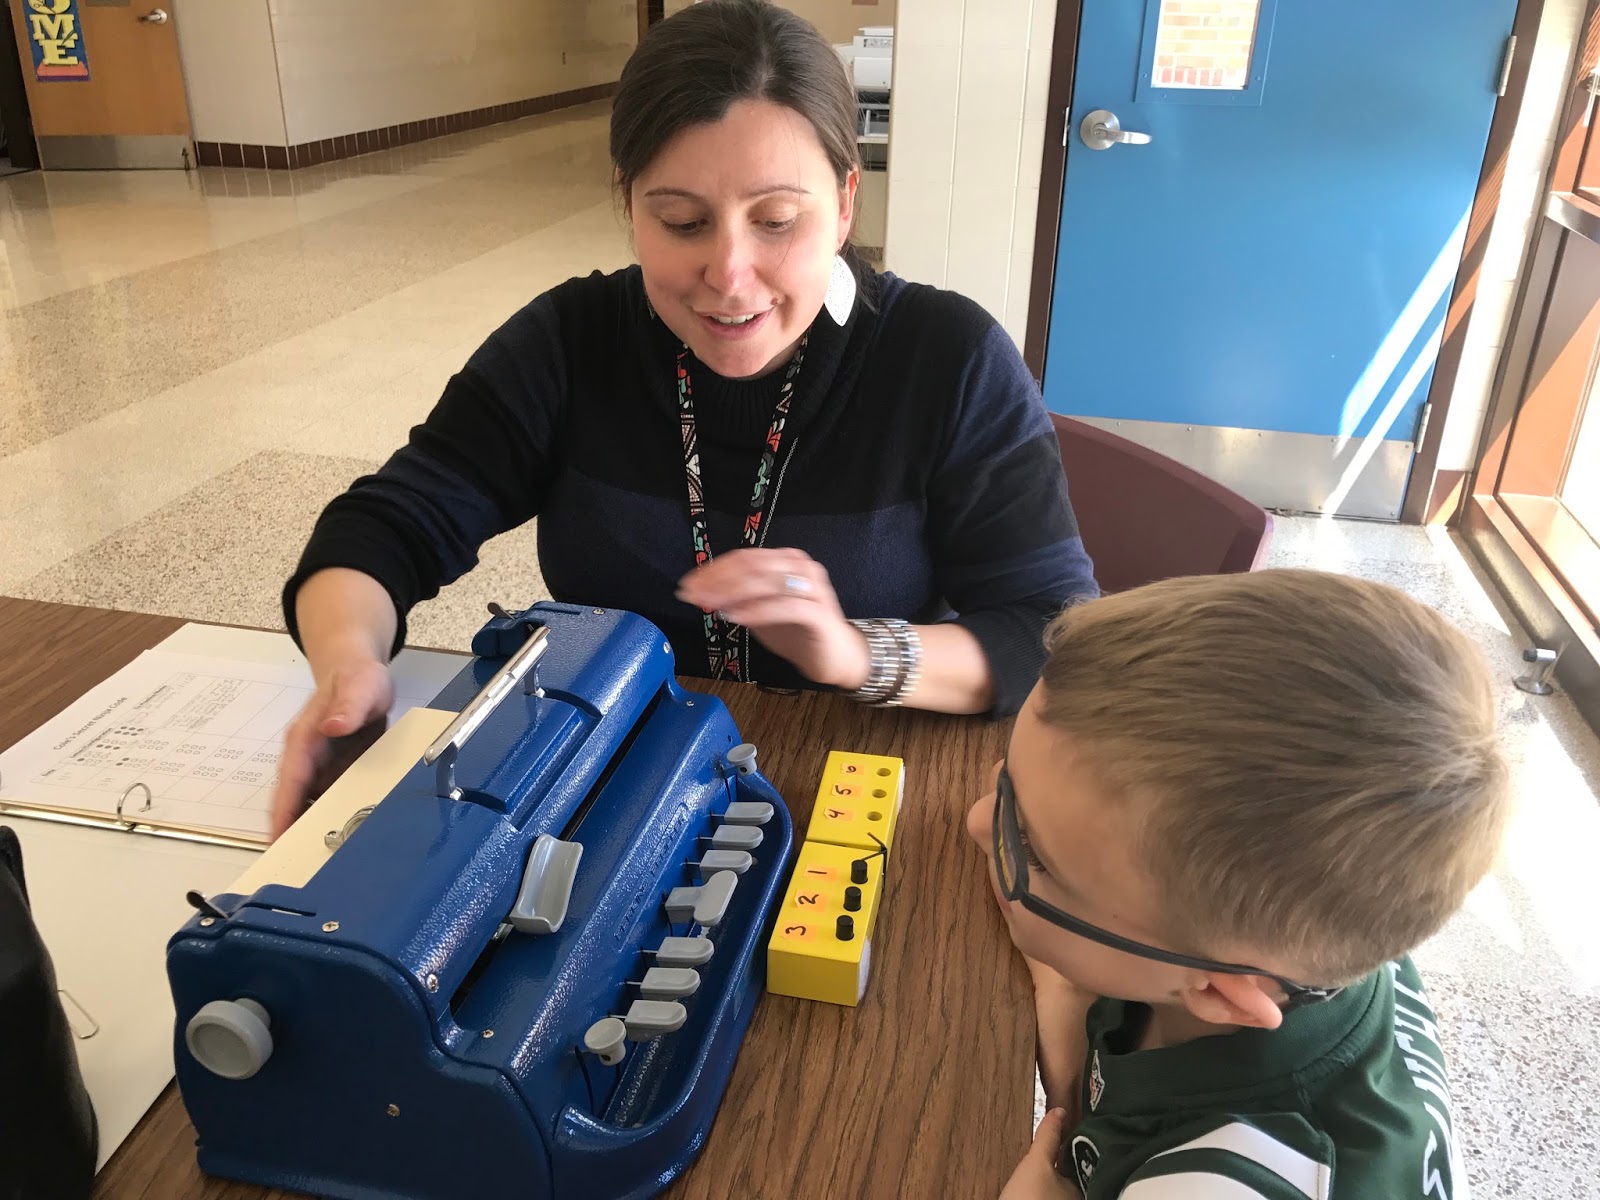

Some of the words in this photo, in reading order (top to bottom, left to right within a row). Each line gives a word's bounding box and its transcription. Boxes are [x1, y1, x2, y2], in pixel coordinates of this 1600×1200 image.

[72, 719, 97, 736] Secret
[91, 708, 112, 722] Ninja
[108, 696, 128, 709] Code
[835, 784, 853, 797] 5
[828, 808, 846, 819] 4
[797, 892, 820, 906] 2
[784, 924, 807, 937] 3
